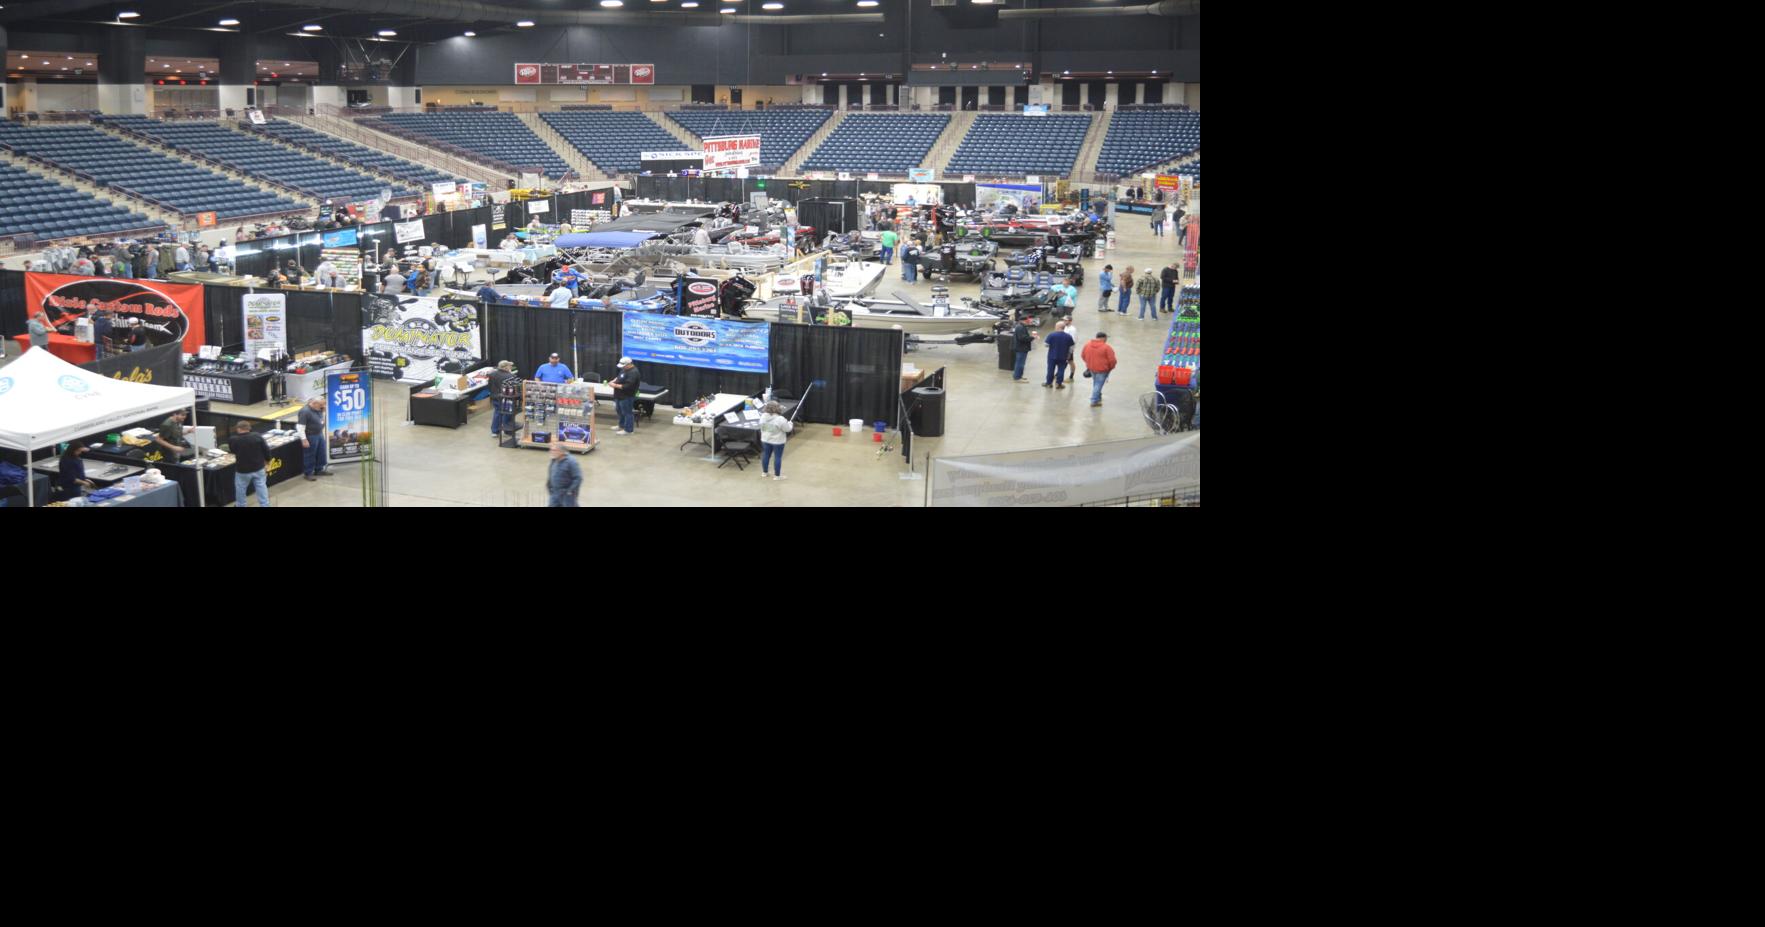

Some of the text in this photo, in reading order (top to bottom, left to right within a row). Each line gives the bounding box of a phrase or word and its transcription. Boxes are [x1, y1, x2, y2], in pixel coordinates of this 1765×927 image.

[89, 298, 143, 313] Custom
[145, 302, 180, 318] Rods
[675, 329, 715, 338] OUTDOORS
[334, 388, 366, 411] $50
